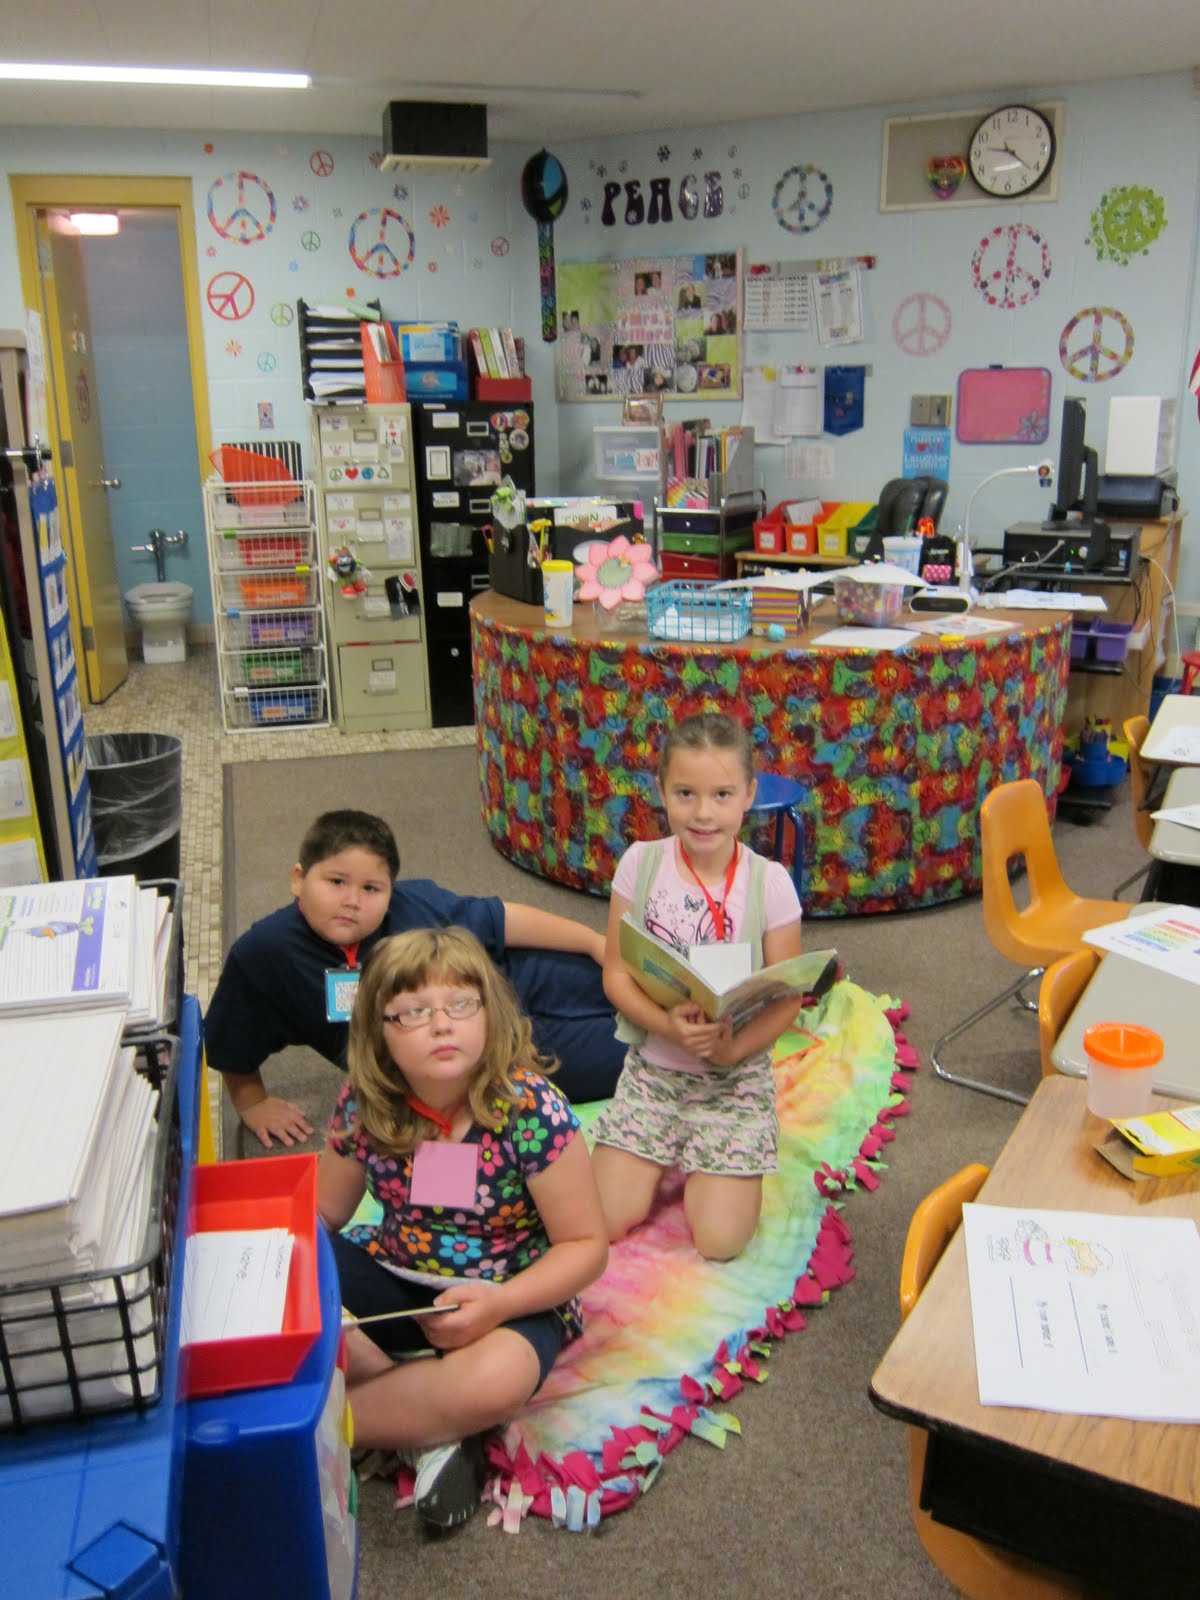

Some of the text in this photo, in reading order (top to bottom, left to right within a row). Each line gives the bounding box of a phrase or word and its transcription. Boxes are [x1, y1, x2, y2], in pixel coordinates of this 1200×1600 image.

[1006, 109, 1018, 123] 12
[992, 118, 1000, 130] 11
[978, 131, 989, 144] 10
[1035, 125, 1042, 138] 2
[974, 149, 981, 159] 9
[977, 164, 985, 176] 8
[1033, 160, 1040, 171] 4
[991, 176, 997, 189] 7
[1022, 174, 1027, 185] 5
[1004, 181, 1012, 192] 6
[600, 170, 724, 227] PEACE
